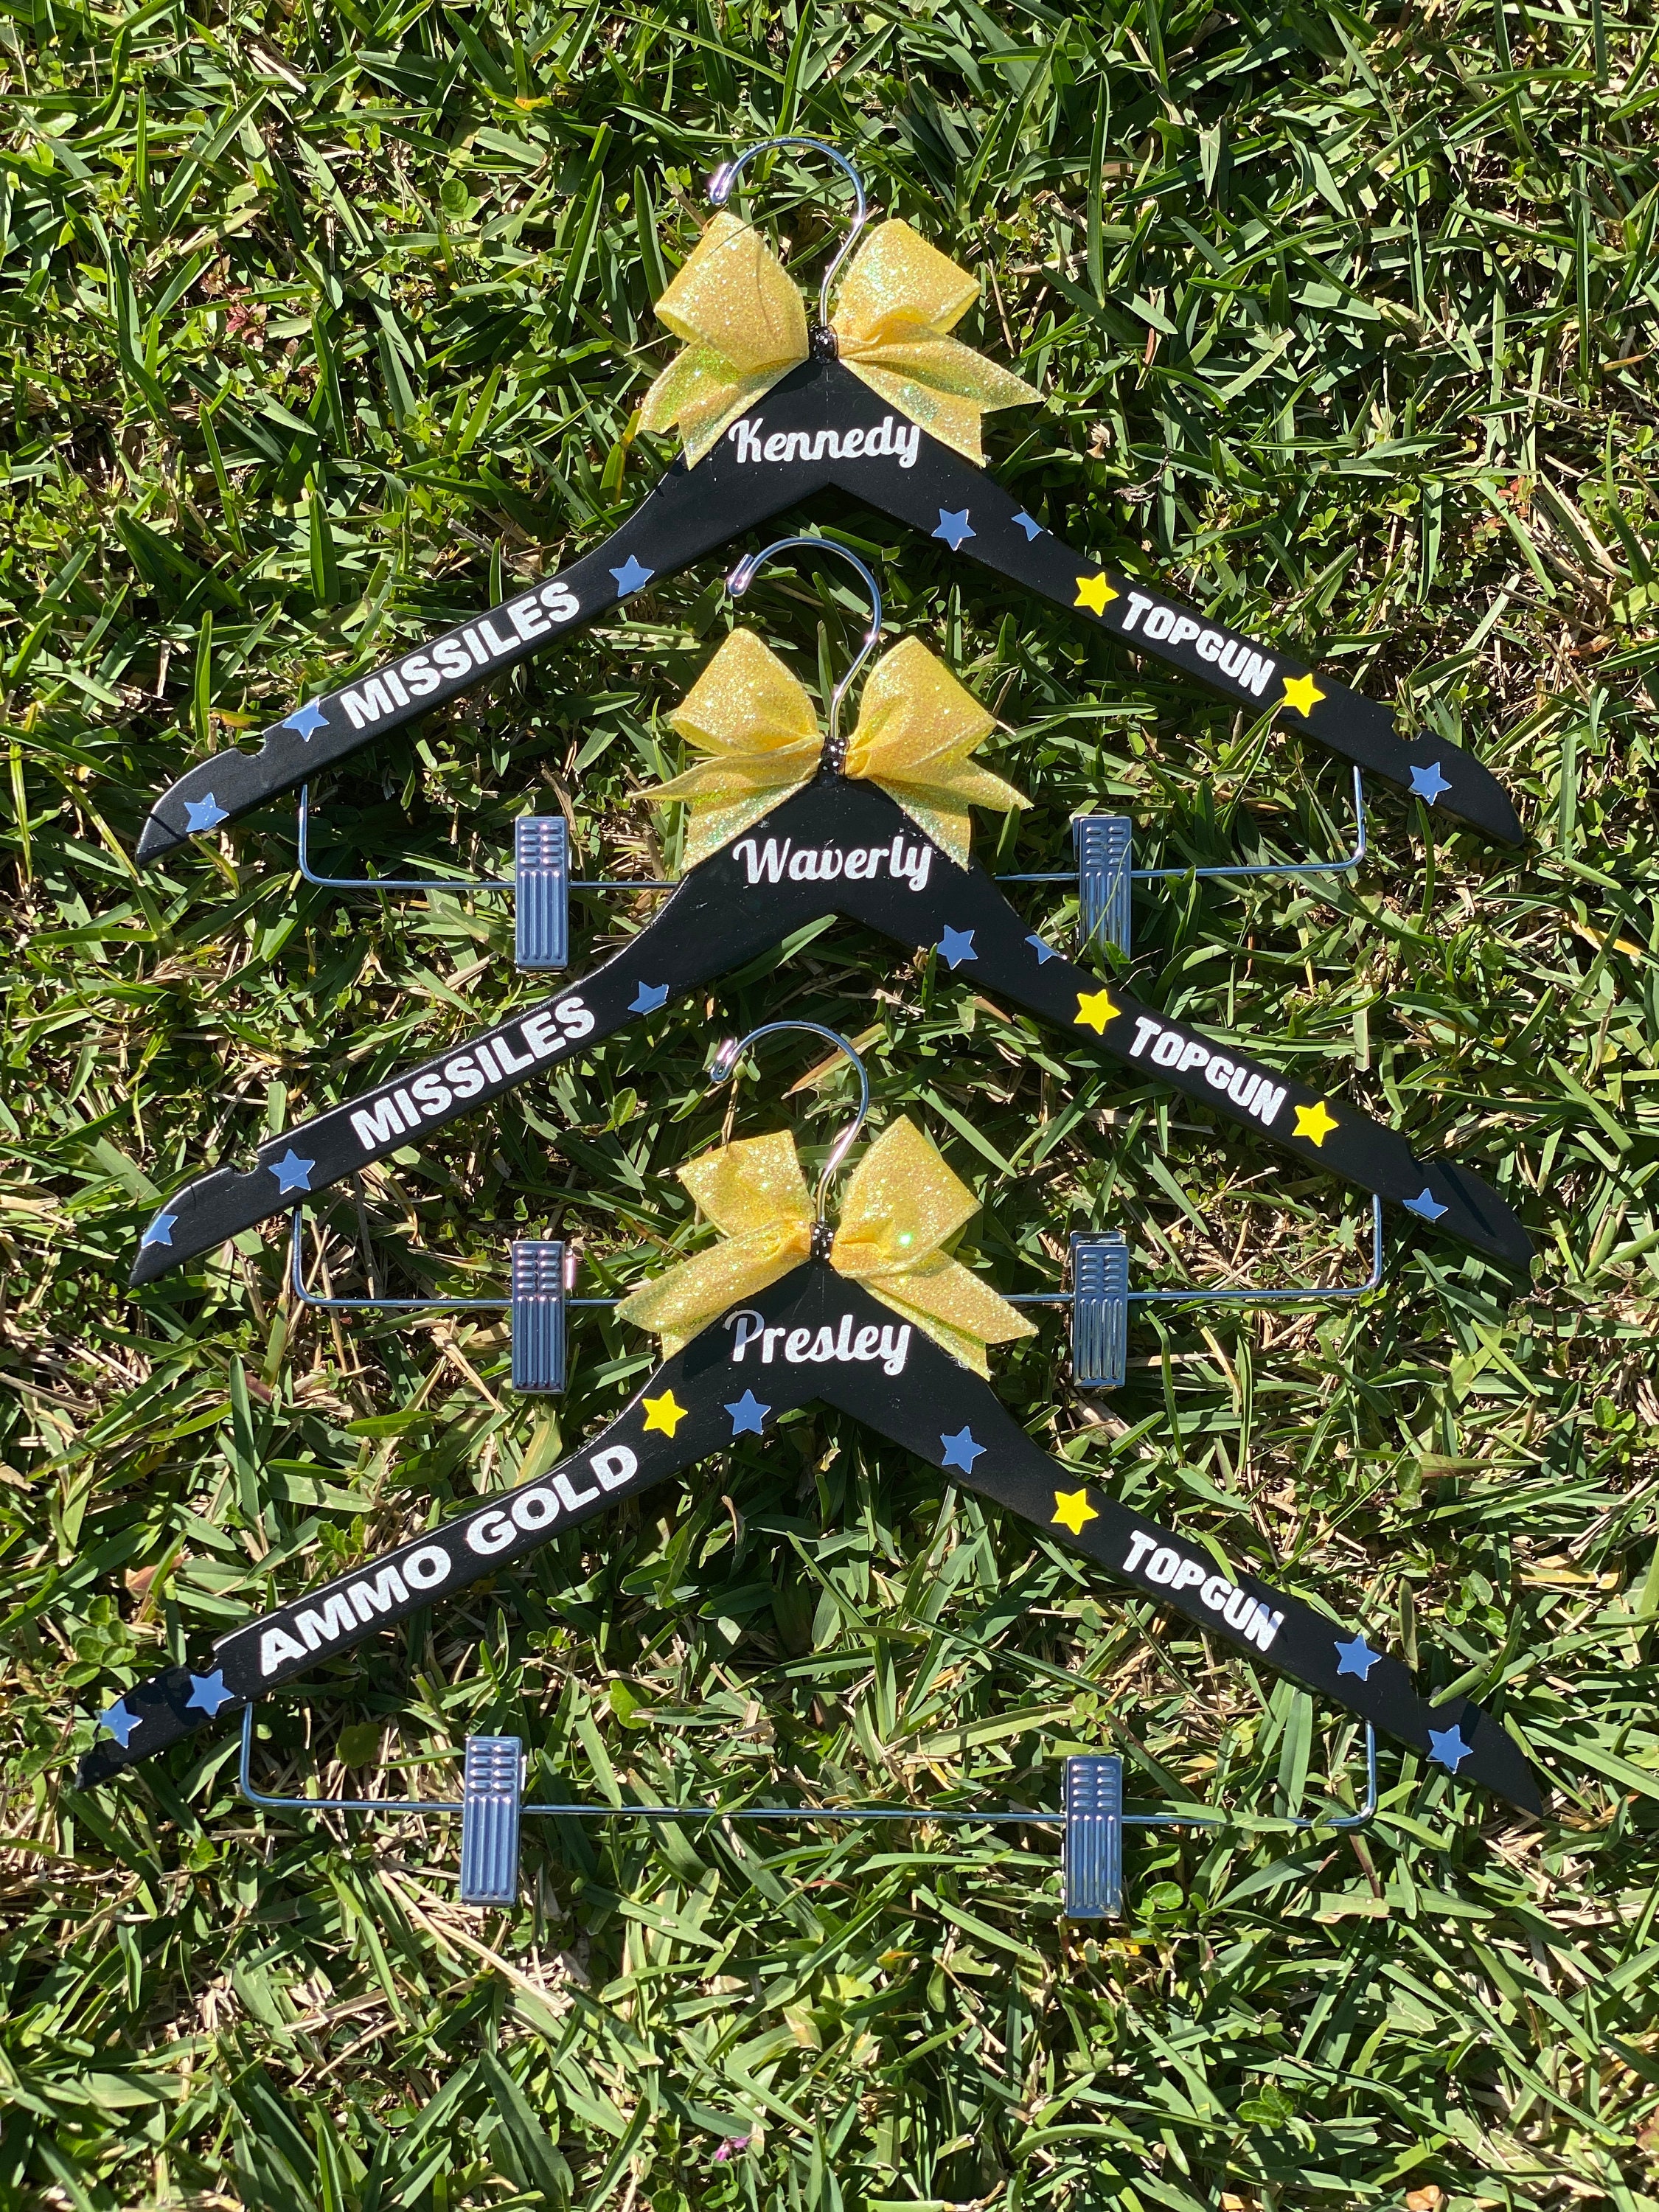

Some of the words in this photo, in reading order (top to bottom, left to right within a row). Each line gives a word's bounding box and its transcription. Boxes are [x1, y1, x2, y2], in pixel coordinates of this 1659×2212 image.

[728, 415, 921, 468] Kennedy
[340, 581, 580, 728] MISSILES
[1122, 591, 1276, 697] TOPGUN
[732, 836, 933, 891] Waverly
[350, 996, 595, 1150] MISSILES
[1129, 1016, 1287, 1127] TOPGUN
[726, 1310, 913, 1376] Presley
[260, 1545, 452, 1677] AMMO
[465, 1444, 639, 1555] GOLD
[1122, 1529, 1284, 1652] TOPGUN
